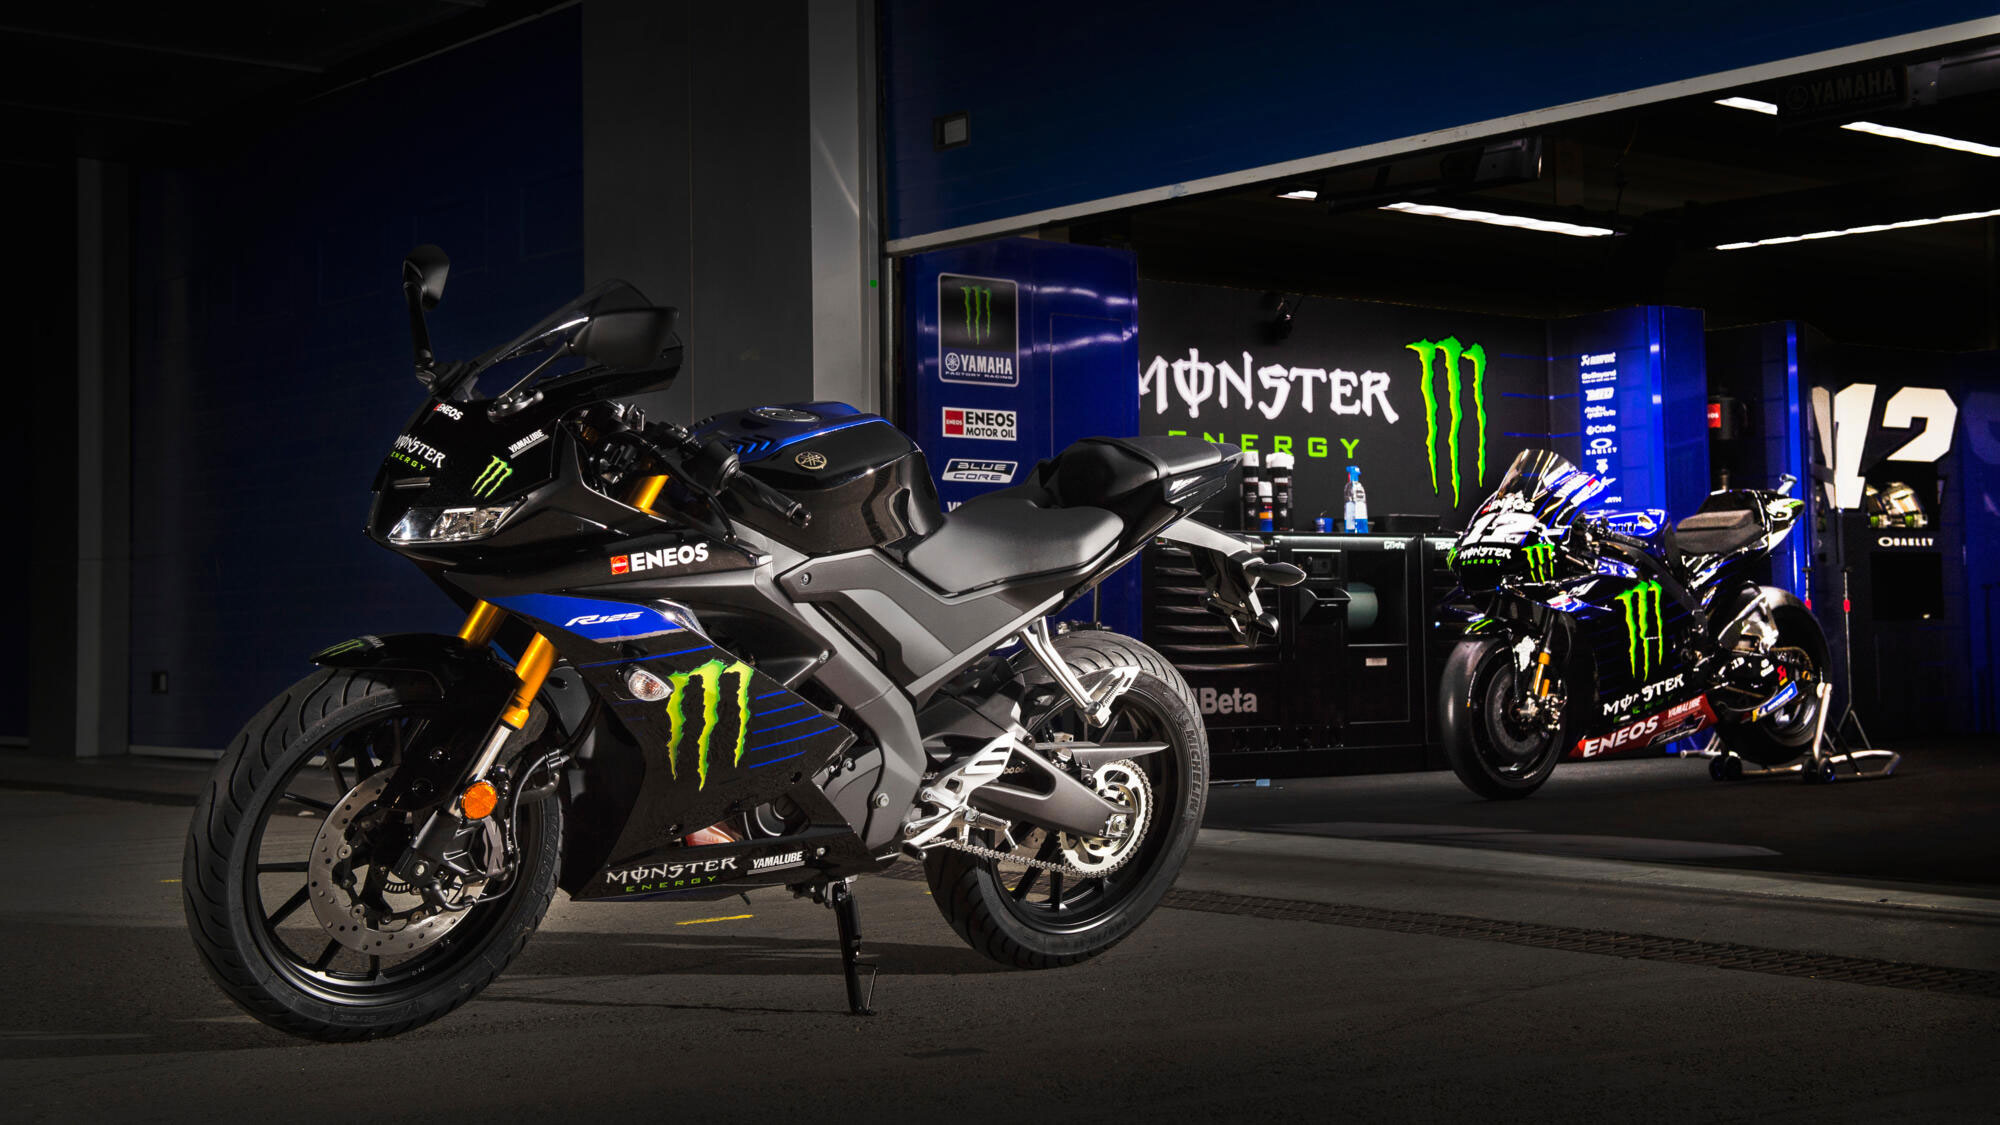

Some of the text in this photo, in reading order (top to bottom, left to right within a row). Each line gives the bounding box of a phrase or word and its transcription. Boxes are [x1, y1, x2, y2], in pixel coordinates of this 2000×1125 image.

[1811, 69, 1896, 104] YAMAHA
[960, 354, 1013, 375] YAMAHA
[1139, 348, 1399, 424] MONSTER
[437, 403, 464, 420] ENEOS
[965, 411, 1015, 428] ENEOS
[508, 429, 545, 453] YAMALUBE
[966, 427, 1015, 438] MOTOR OIL
[395, 433, 446, 469] MONSTER
[1168, 430, 1360, 458] ERGY
[1586, 447, 1617, 455] OAKLEY
[391, 451, 427, 471] ENERGY
[957, 462, 1007, 471] BLUE
[953, 472, 1003, 481] CORE
[1893, 537, 1934, 547] OAKLEY
[630, 543, 709, 572] ENEOS
[1460, 546, 1511, 559] MONSTER
[1200, 687, 1258, 714] Beta
[1583, 715, 1660, 758] ENEOS
[1183, 729, 1202, 816] MICHELIN
[753, 851, 804, 869] YAMALUBE
[606, 857, 738, 884] MONSTER
[626, 875, 717, 893] ENERGY
